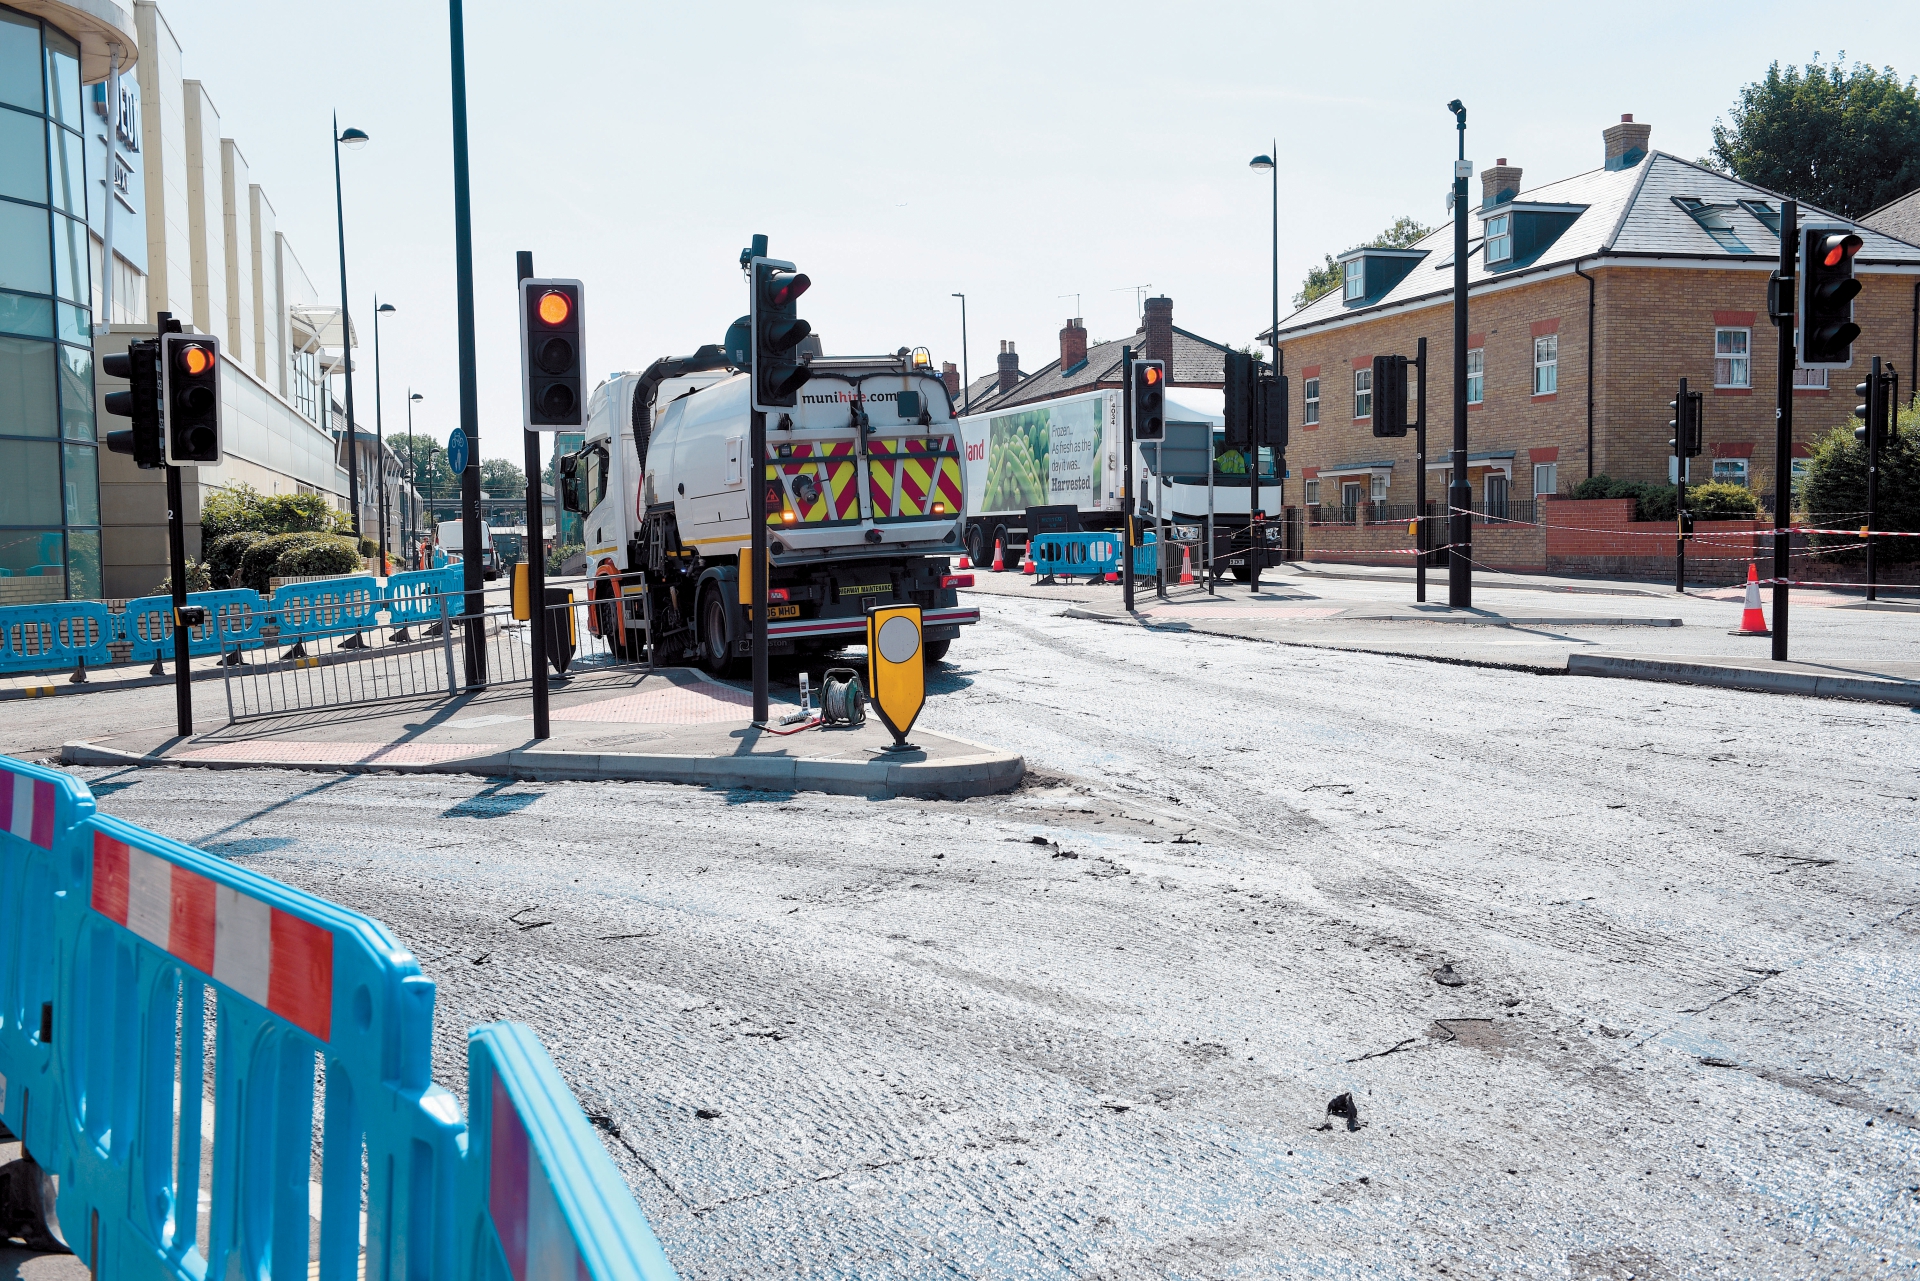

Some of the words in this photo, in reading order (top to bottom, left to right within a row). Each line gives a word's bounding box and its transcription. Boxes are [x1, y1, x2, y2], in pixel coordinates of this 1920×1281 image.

[802, 391, 898, 404] munihire.com
[1060, 440, 1073, 454] fresh
[1074, 443, 1081, 452] as
[1081, 438, 1091, 451] the
[1051, 475, 1091, 491] Harvested
[168, 509, 174, 520] 2
